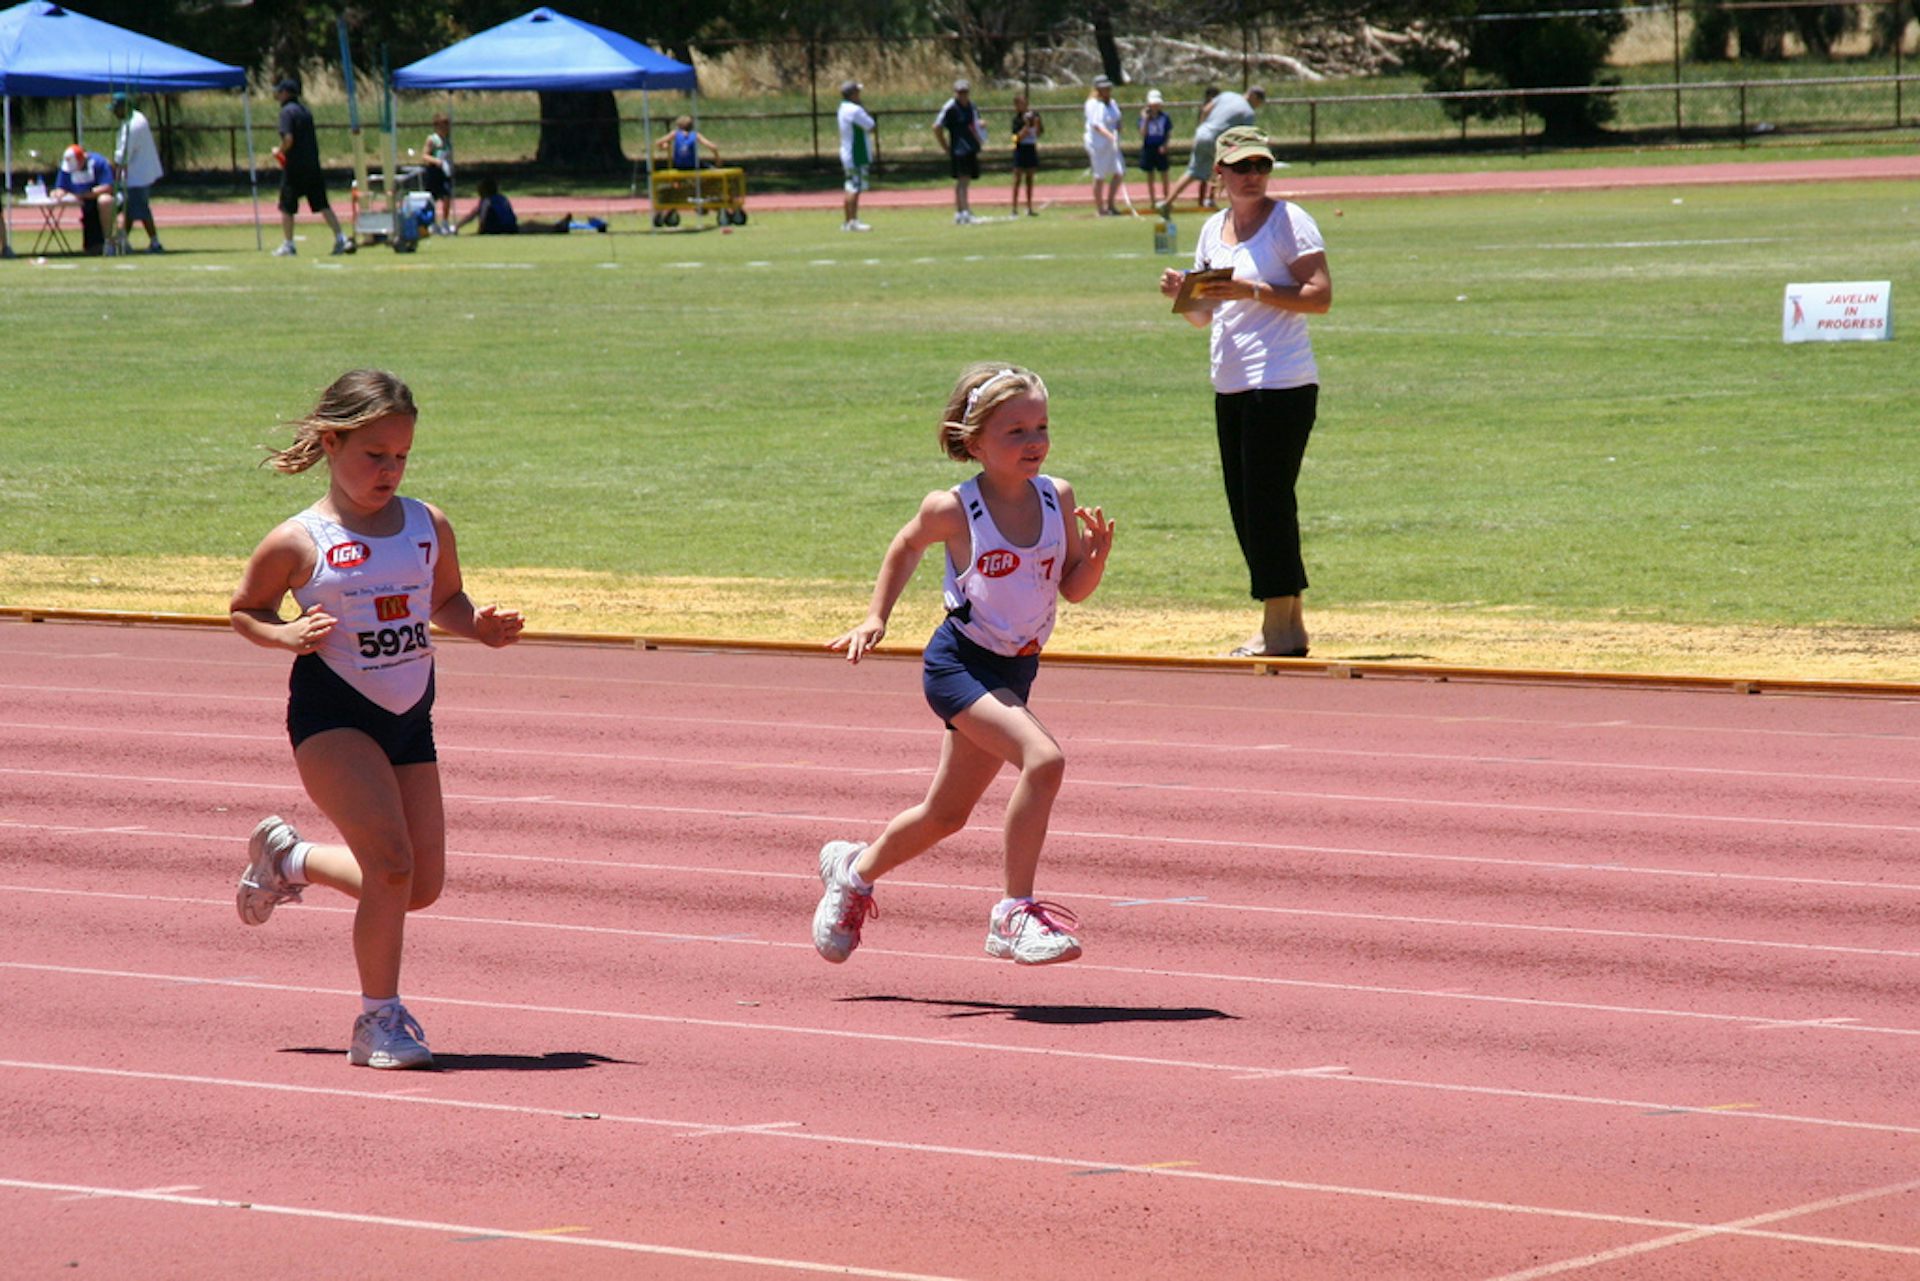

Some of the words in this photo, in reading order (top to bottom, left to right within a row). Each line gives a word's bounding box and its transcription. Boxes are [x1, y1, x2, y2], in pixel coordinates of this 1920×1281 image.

[1826, 293, 1879, 305] JAVELIN
[1844, 306, 1859, 316] IN
[1817, 319, 1884, 330] PROGRESS
[331, 543, 365, 564] IGA
[418, 541, 431, 565] 7
[982, 552, 1014, 575] IGA
[1041, 556, 1055, 580] 7
[357, 622, 428, 659] 5928
